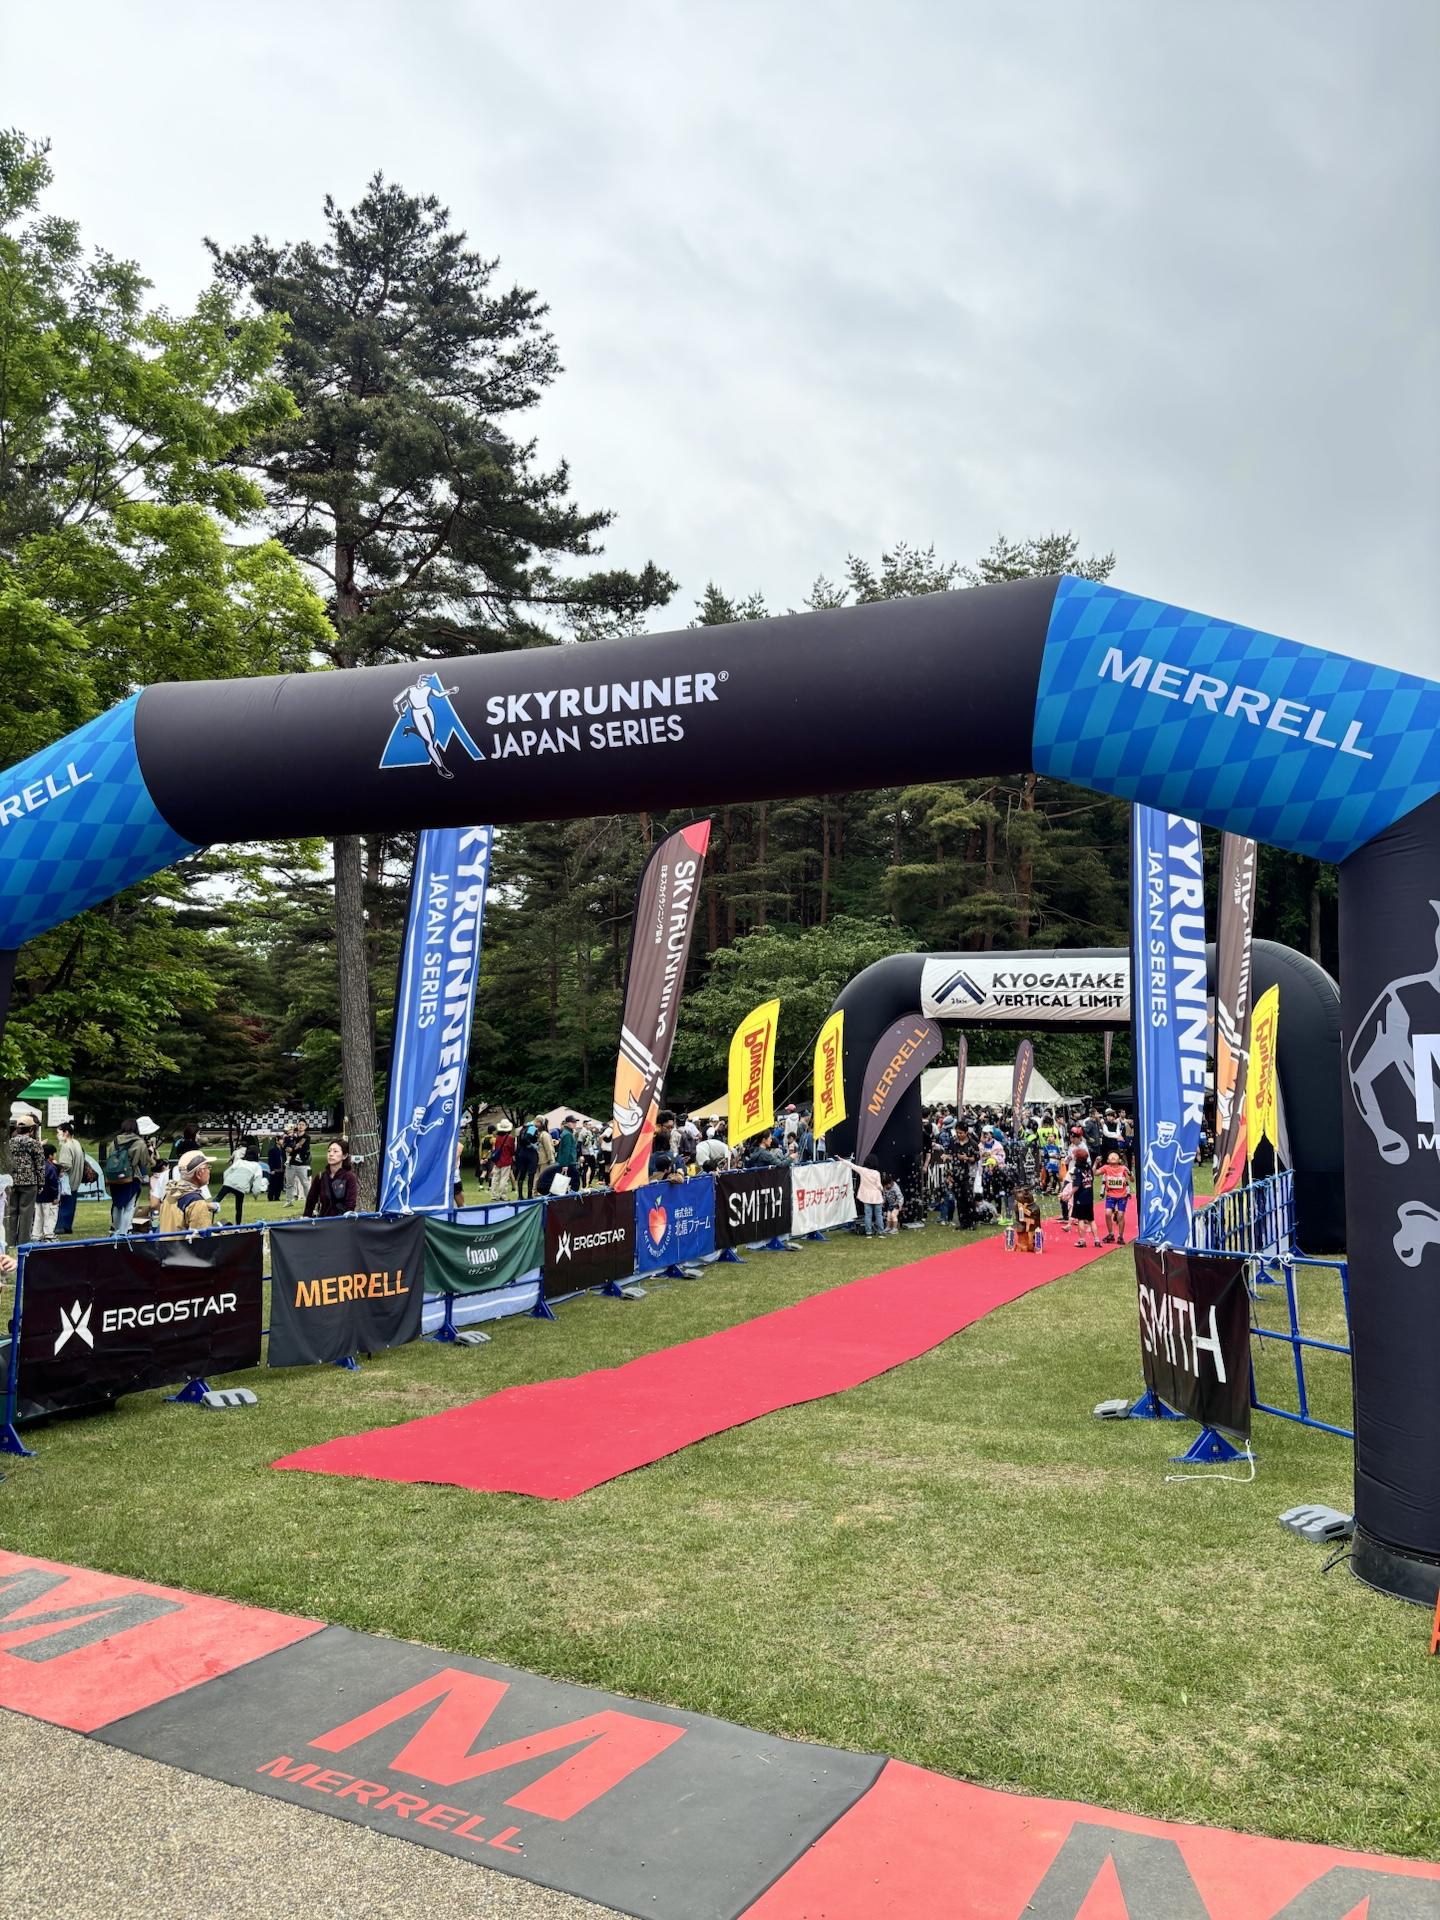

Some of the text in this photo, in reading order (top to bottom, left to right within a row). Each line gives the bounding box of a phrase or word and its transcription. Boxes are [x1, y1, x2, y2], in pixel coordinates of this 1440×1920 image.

[1098, 647, 1374, 760] MERRELL
[491, 714, 684, 760] JAPAN SERIES
[418, 872, 450, 1029] JAPAN SERIES
[1148, 847, 1168, 1028] JAPAN SERIES
[992, 973, 1126, 989] KYOGATAKE
[993, 994, 1124, 1008] VERTICAL LIMIT
[867, 1026, 930, 1117] MERRELL
[674, 1215, 711, 1236] 北信ファーム
[728, 1186, 783, 1227] SMITH
[573, 1228, 626, 1251] ERGOSTAR
[295, 1270, 410, 1308] MERRELL
[102, 1292, 238, 1333] ERGOSTAR
[1140, 1283, 1227, 1384] SMITH
[256, 1755, 527, 1855] MERRELL
